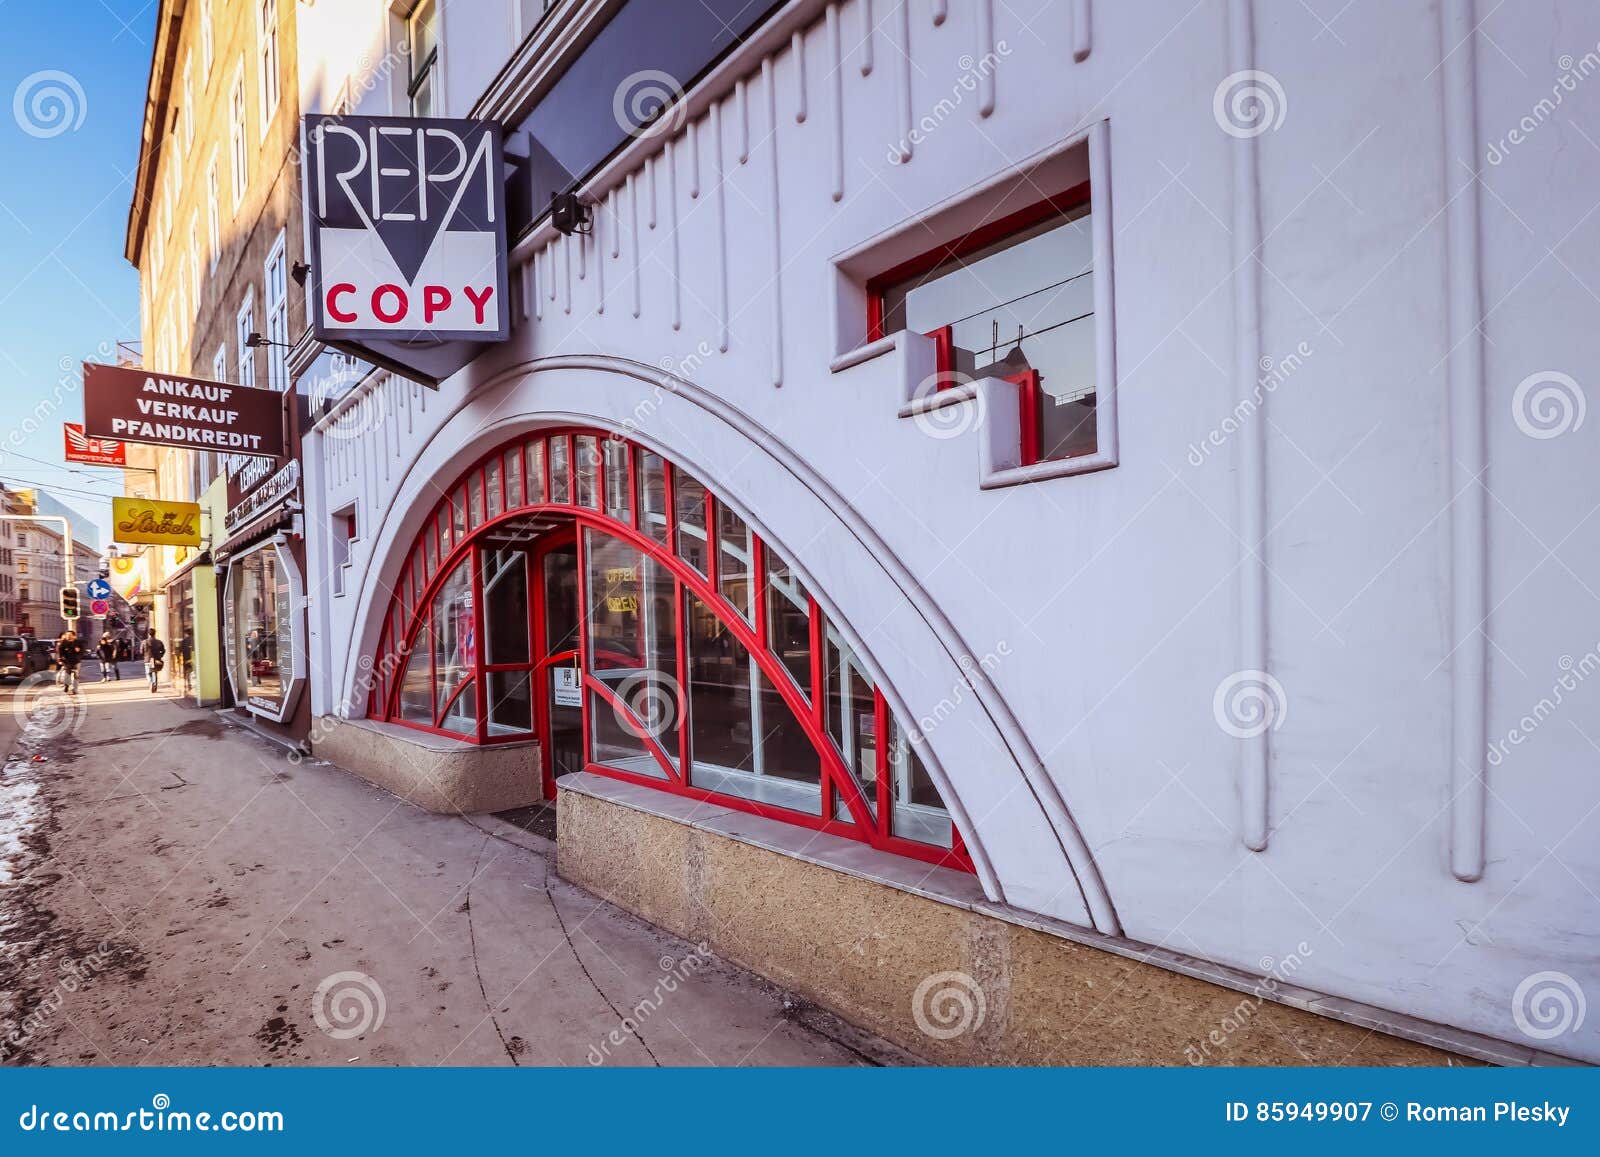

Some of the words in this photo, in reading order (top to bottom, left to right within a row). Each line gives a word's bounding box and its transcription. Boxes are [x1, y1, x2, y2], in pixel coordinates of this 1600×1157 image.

[315, 123, 495, 230] REPA
[325, 282, 494, 325] COPY
[143, 377, 232, 403] ANKAUF
[136, 398, 239, 425] VERKAUF
[112, 418, 262, 449] PFANDKREDIT
[118, 508, 196, 536] Ströck
